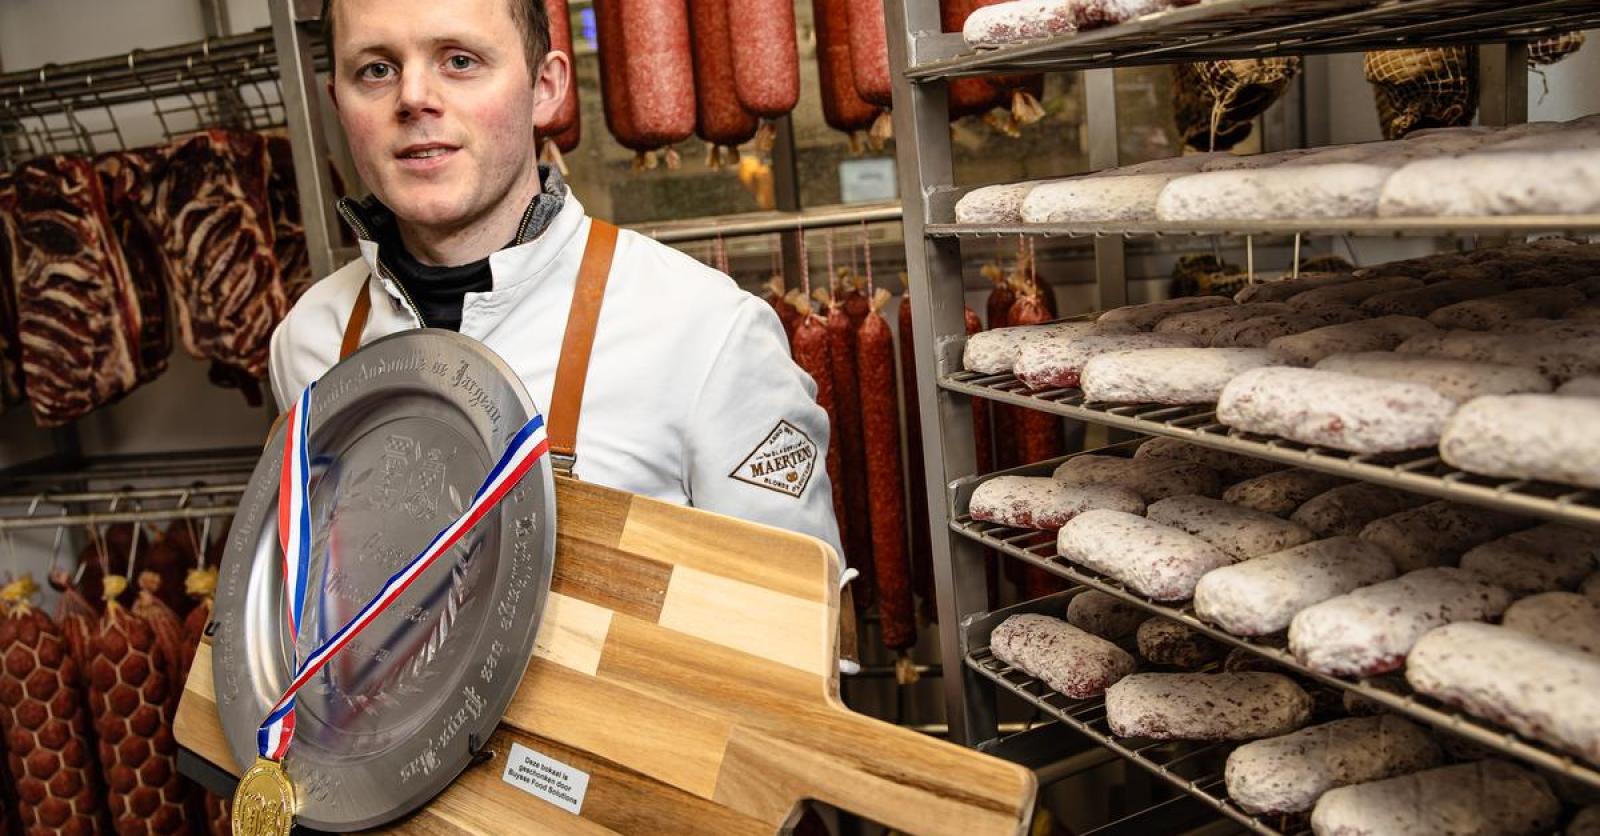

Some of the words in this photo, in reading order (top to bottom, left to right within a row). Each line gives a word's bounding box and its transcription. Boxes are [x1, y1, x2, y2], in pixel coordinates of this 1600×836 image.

[518, 764, 556, 785] geschonken
[556, 780, 572, 792] door
[524, 756, 541, 769] Deze
[541, 763, 562, 778] bokaal
[531, 778, 548, 792] Food
[548, 785, 577, 805] Solutions
